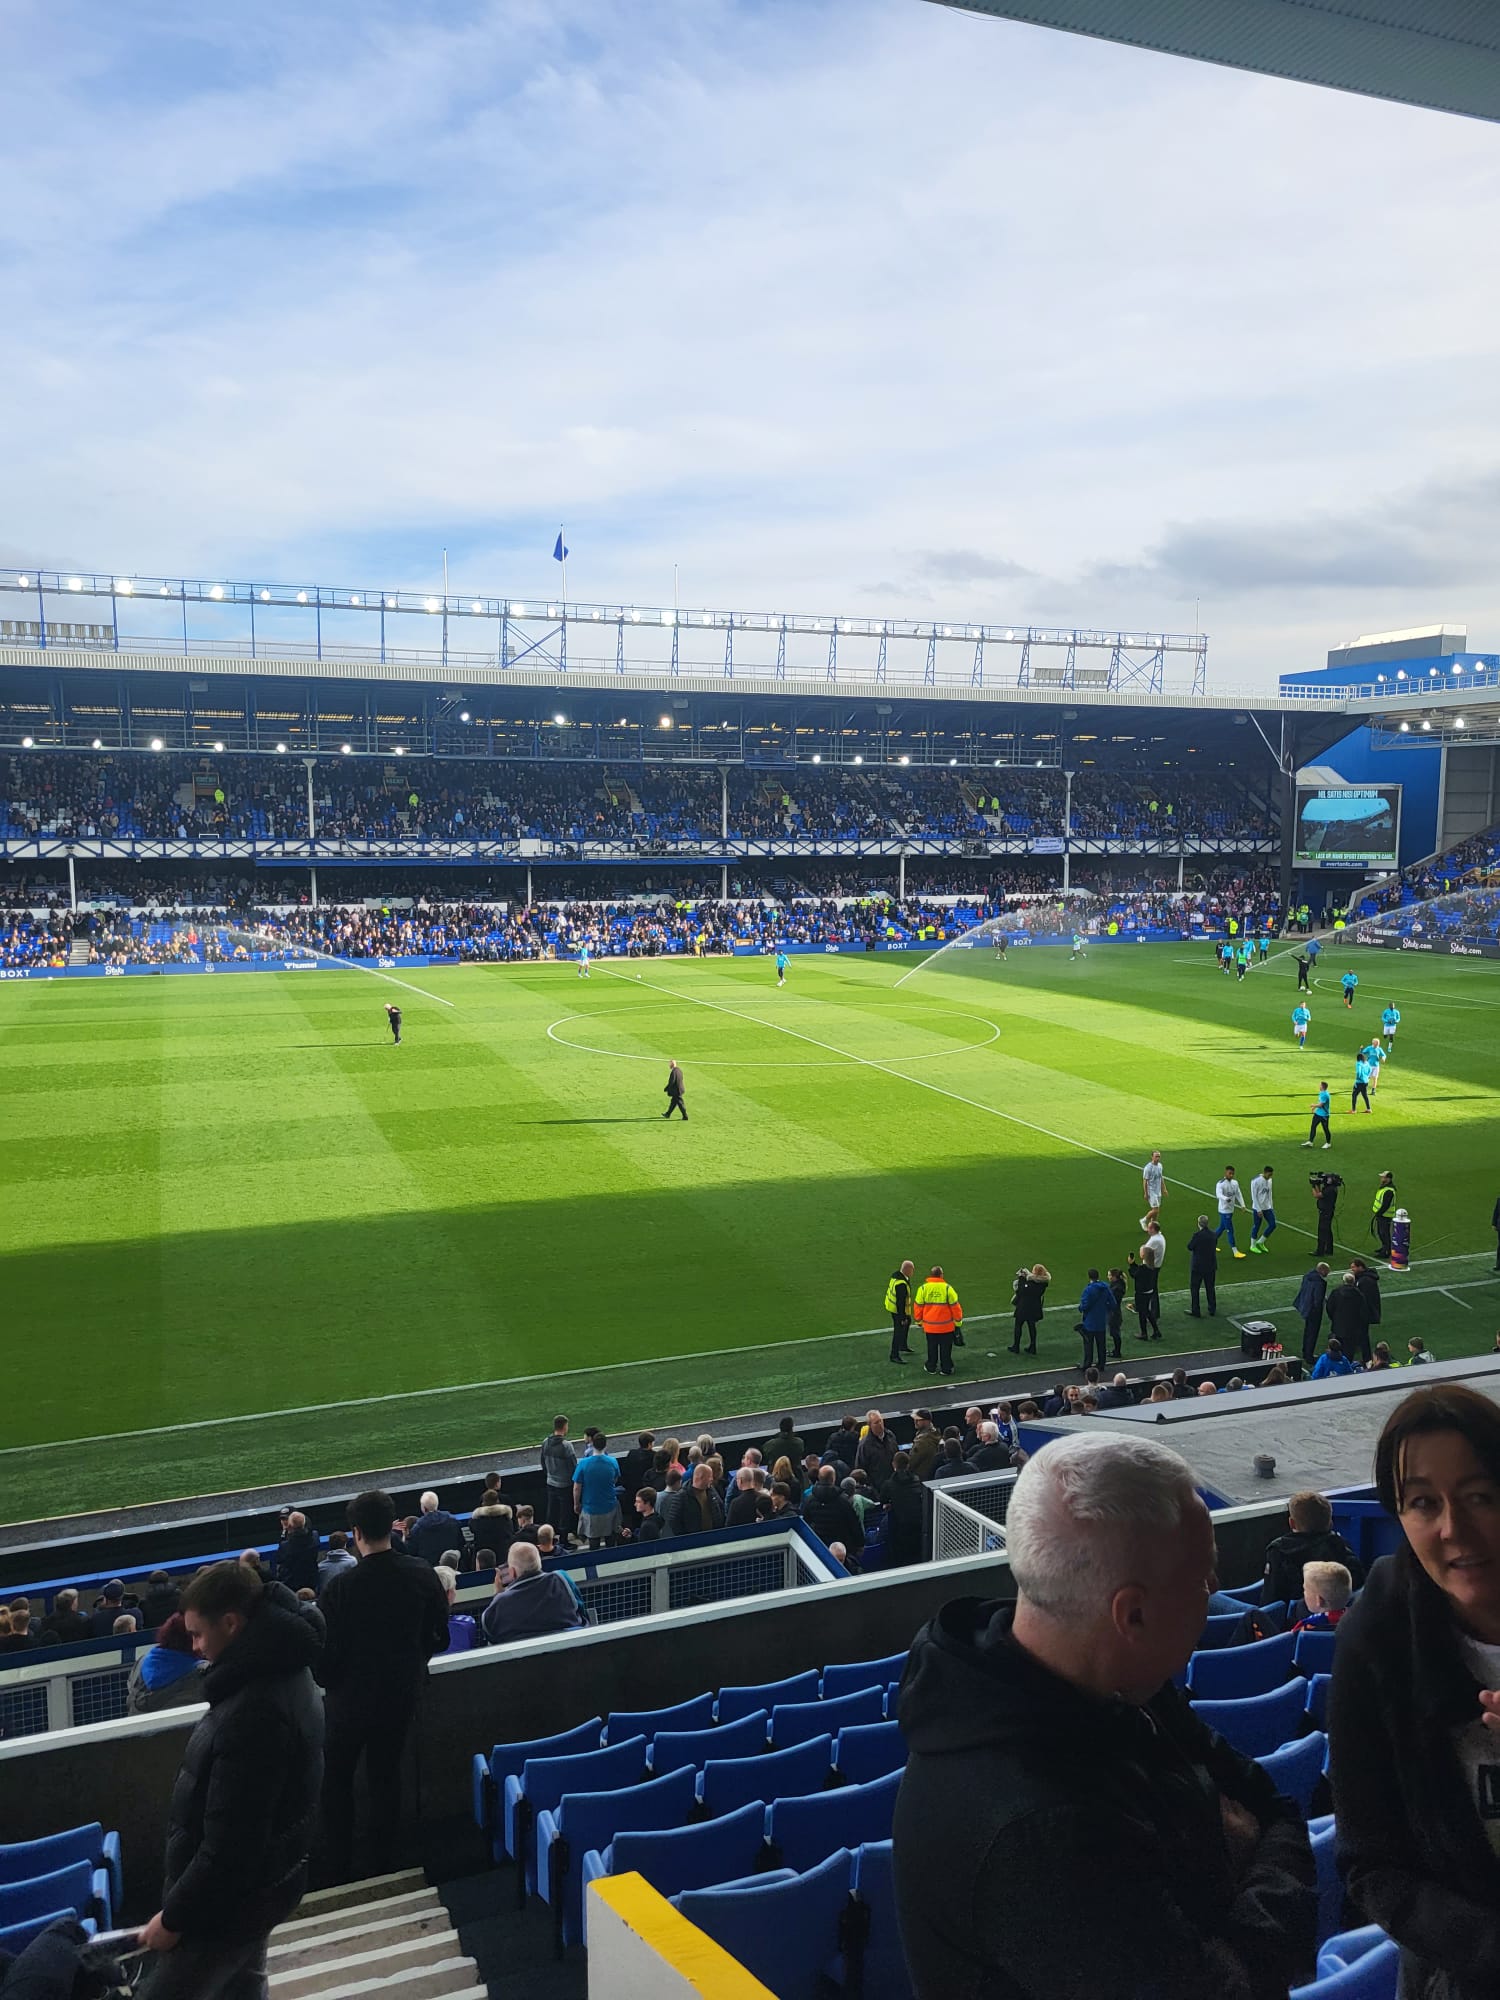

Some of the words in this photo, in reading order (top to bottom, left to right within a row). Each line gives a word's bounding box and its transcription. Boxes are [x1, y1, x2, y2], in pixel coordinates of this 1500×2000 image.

[887, 942, 908, 950] BOXT
[1402, 937, 1433, 950] Stake.com
[1450, 942, 1482, 955] Stake.com
[292, 961, 317, 969] hummel
[0, 969, 31, 978] BOXT
